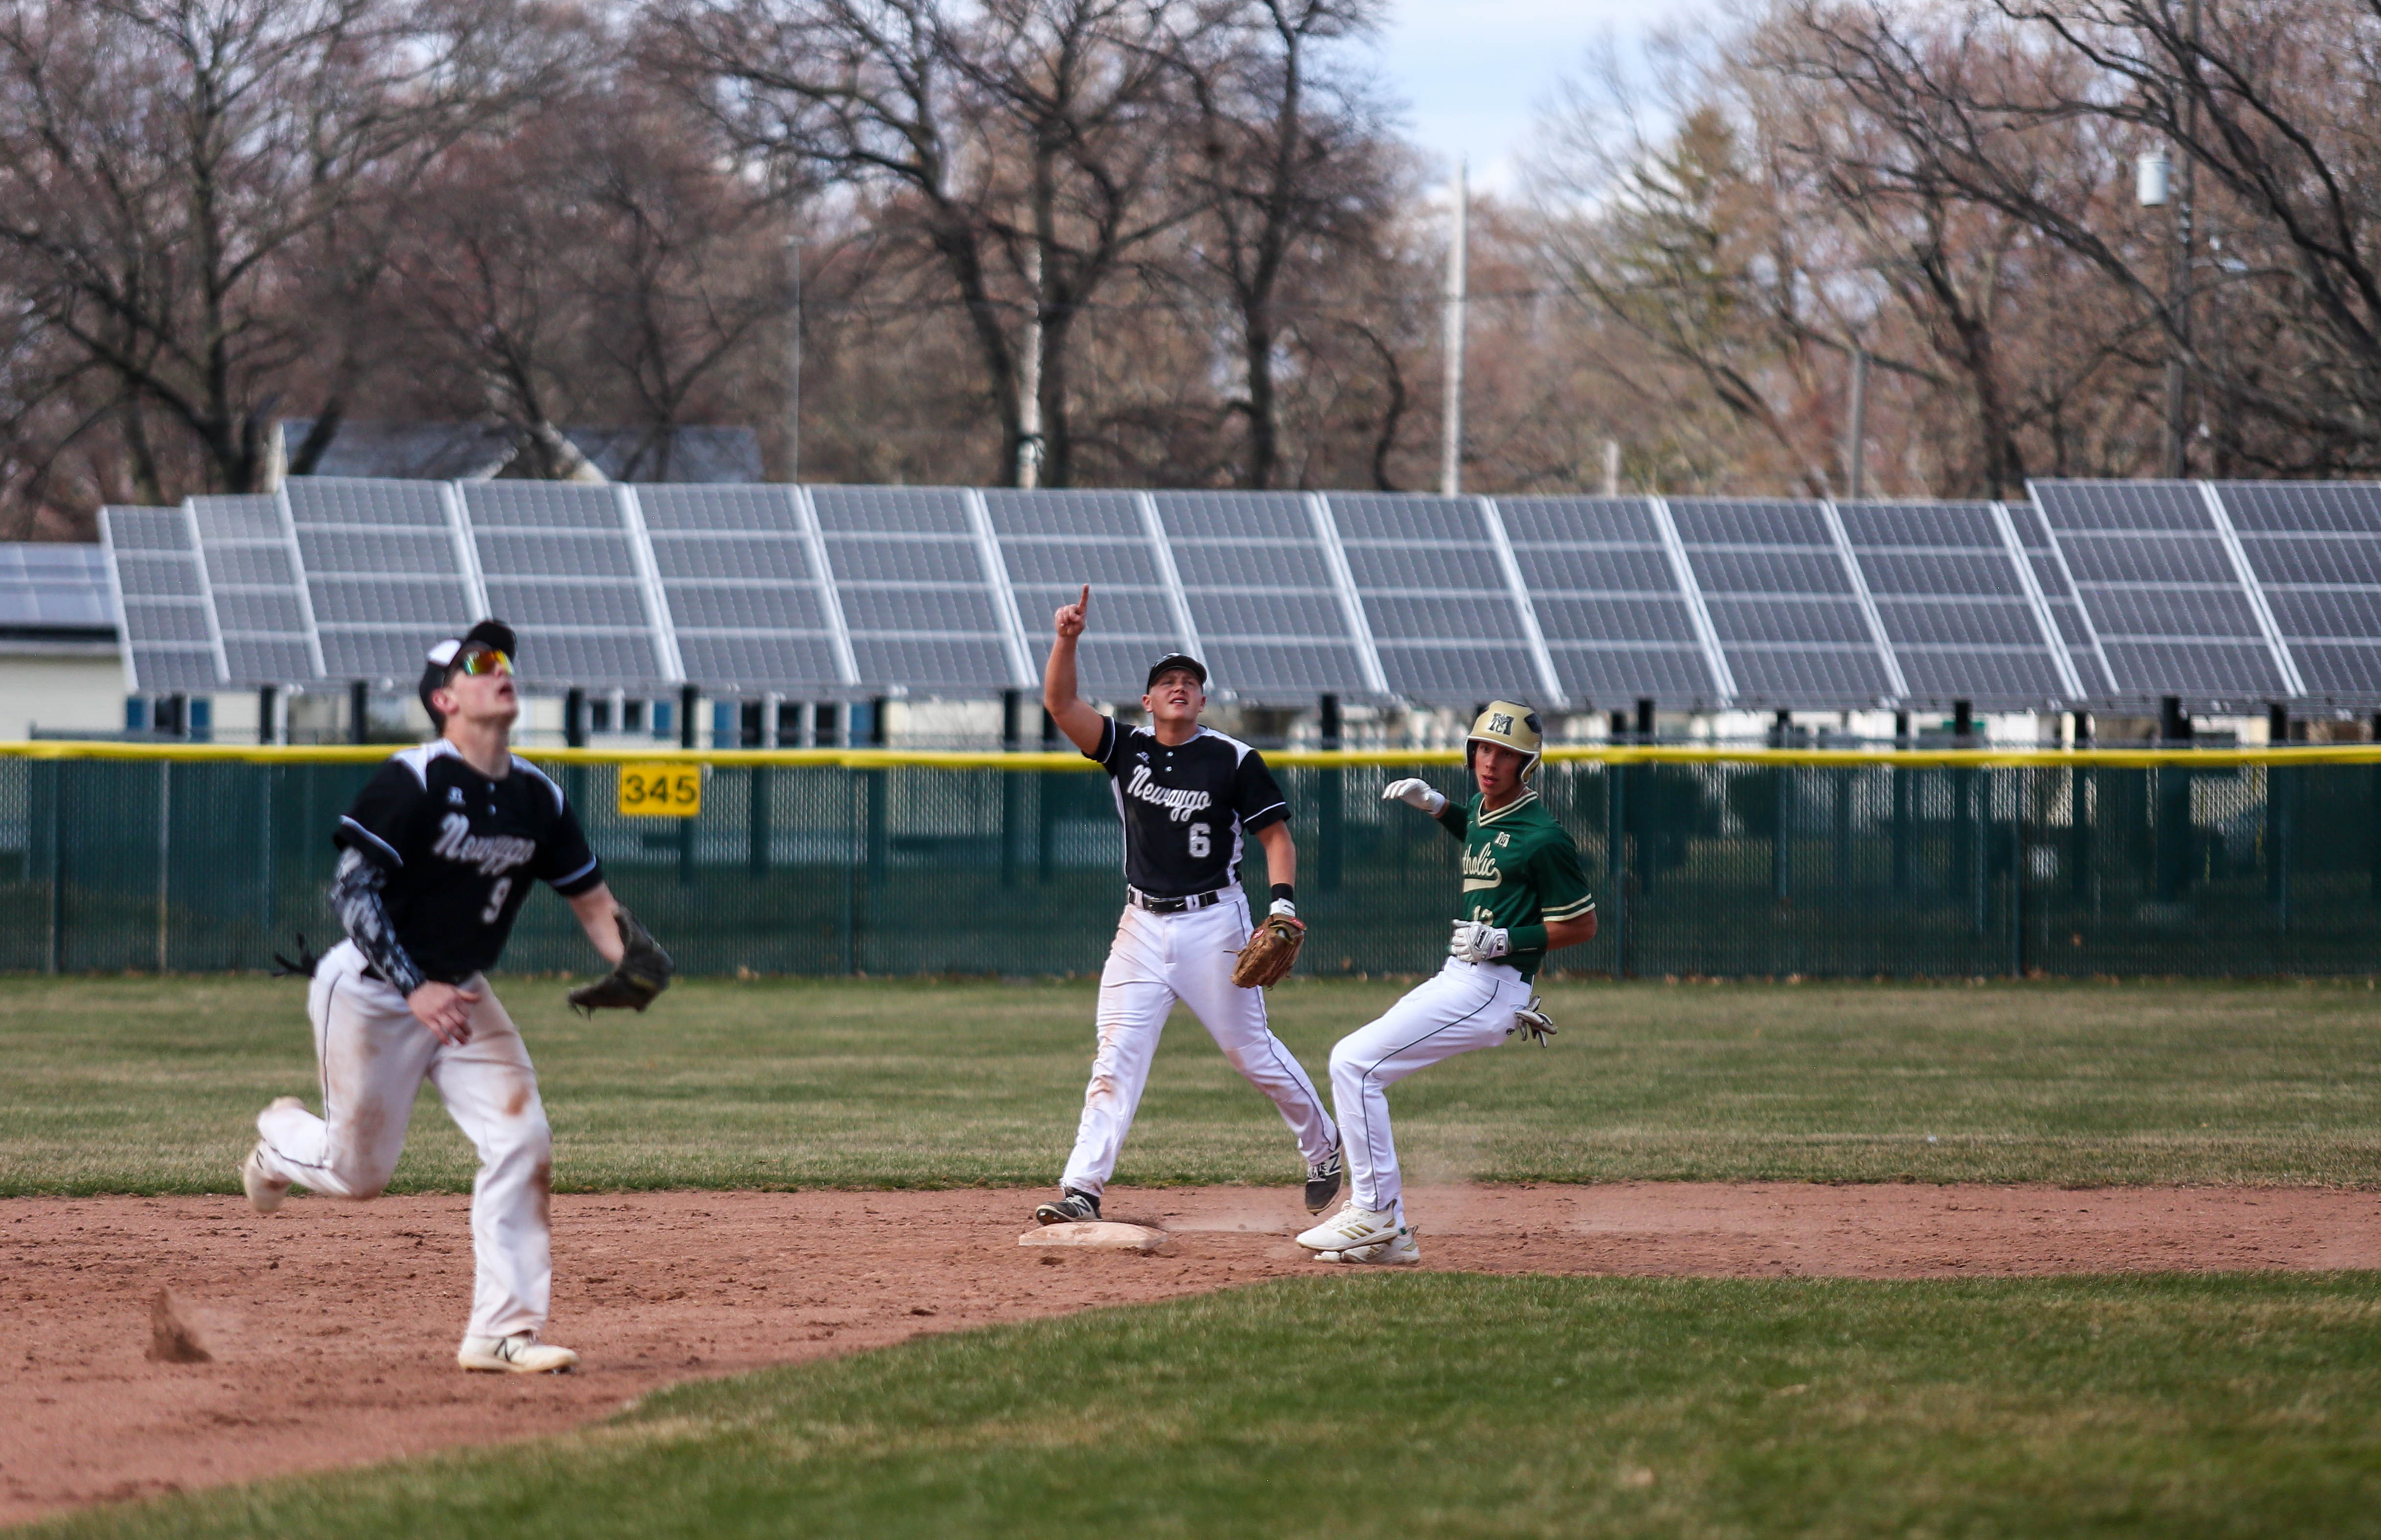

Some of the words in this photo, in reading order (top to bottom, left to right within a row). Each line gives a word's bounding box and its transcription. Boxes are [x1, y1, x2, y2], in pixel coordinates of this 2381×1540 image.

[625, 774, 697, 804] 345
[1127, 764, 1212, 822] Newaygo
[1189, 822, 1211, 857] 6
